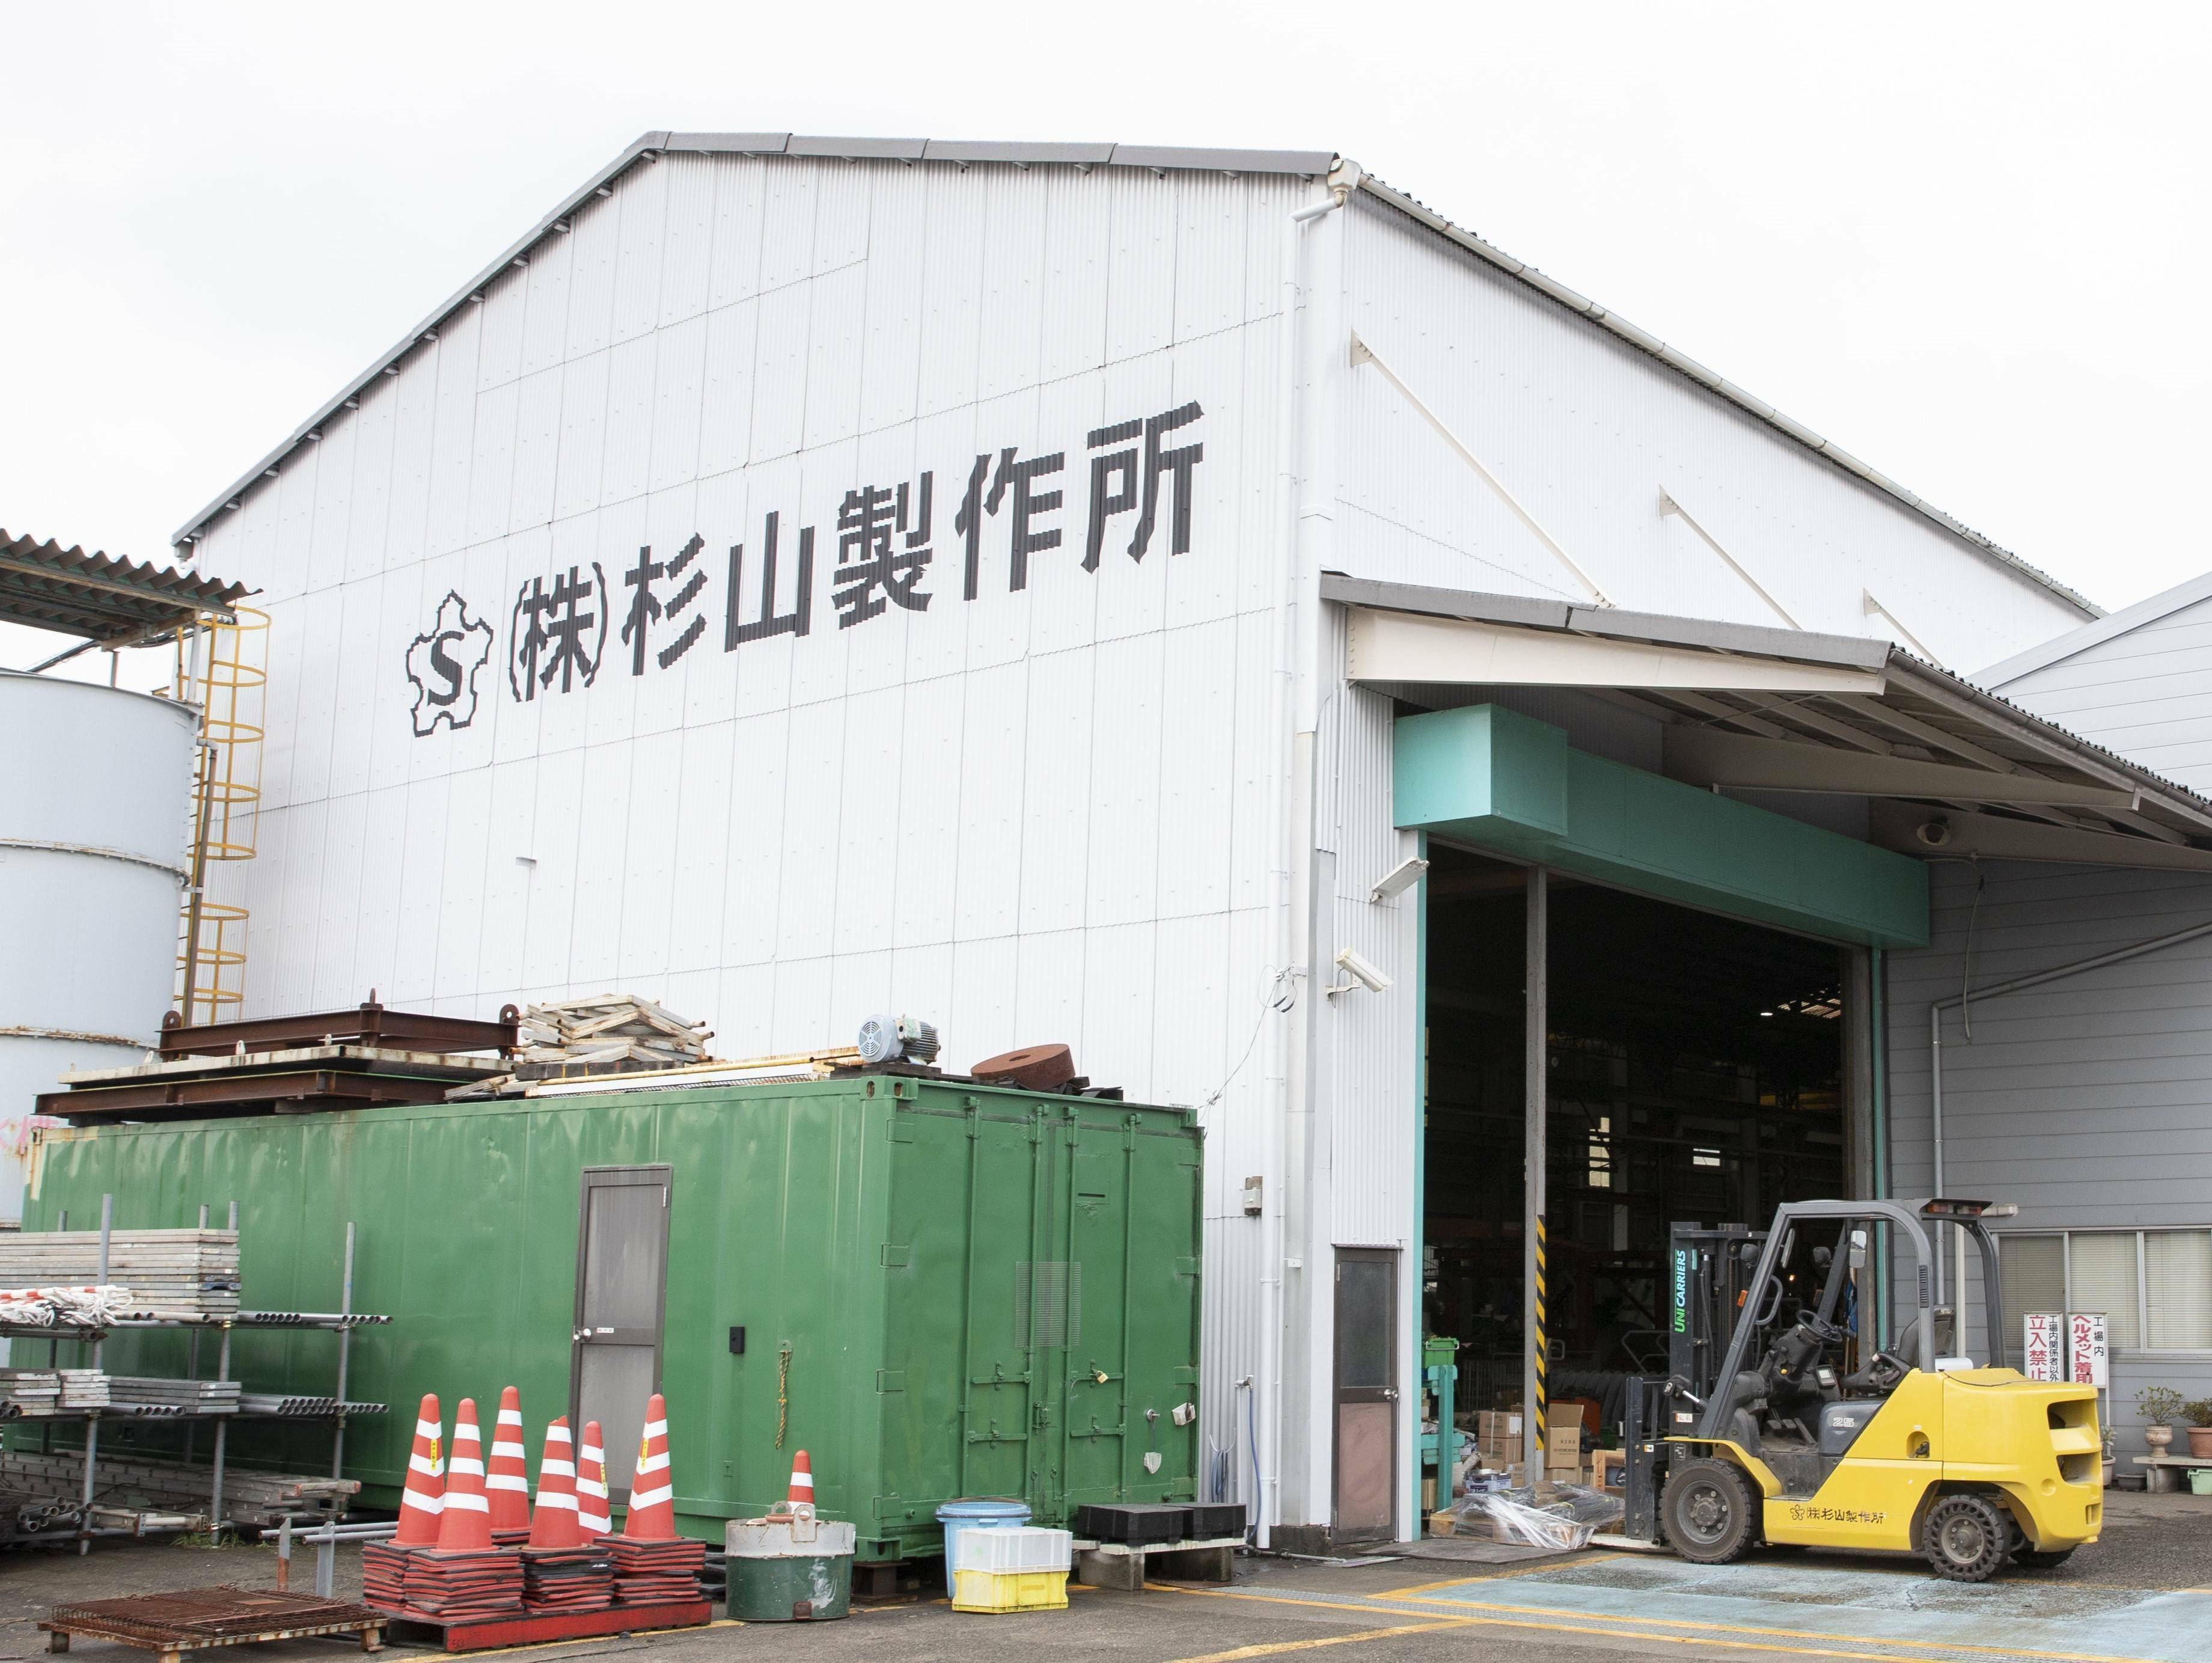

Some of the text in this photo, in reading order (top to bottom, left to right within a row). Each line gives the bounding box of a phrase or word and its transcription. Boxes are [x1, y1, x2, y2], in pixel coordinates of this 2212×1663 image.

[507, 399, 1204, 702] (株)杉山製作所
[1675, 1249, 1686, 1333] UNICARRIERS
[2029, 1314, 2047, 1380] 立入禁止
[2049, 1315, 2059, 1382] 工場内関係者以外
[2073, 1315, 2093, 1384] ヘルメット着用
[2094, 1317, 2104, 1356] 工場内
[1832, 1417, 1854, 1428] 25
[1806, 1506, 1884, 1525] (株)杉山製作所
